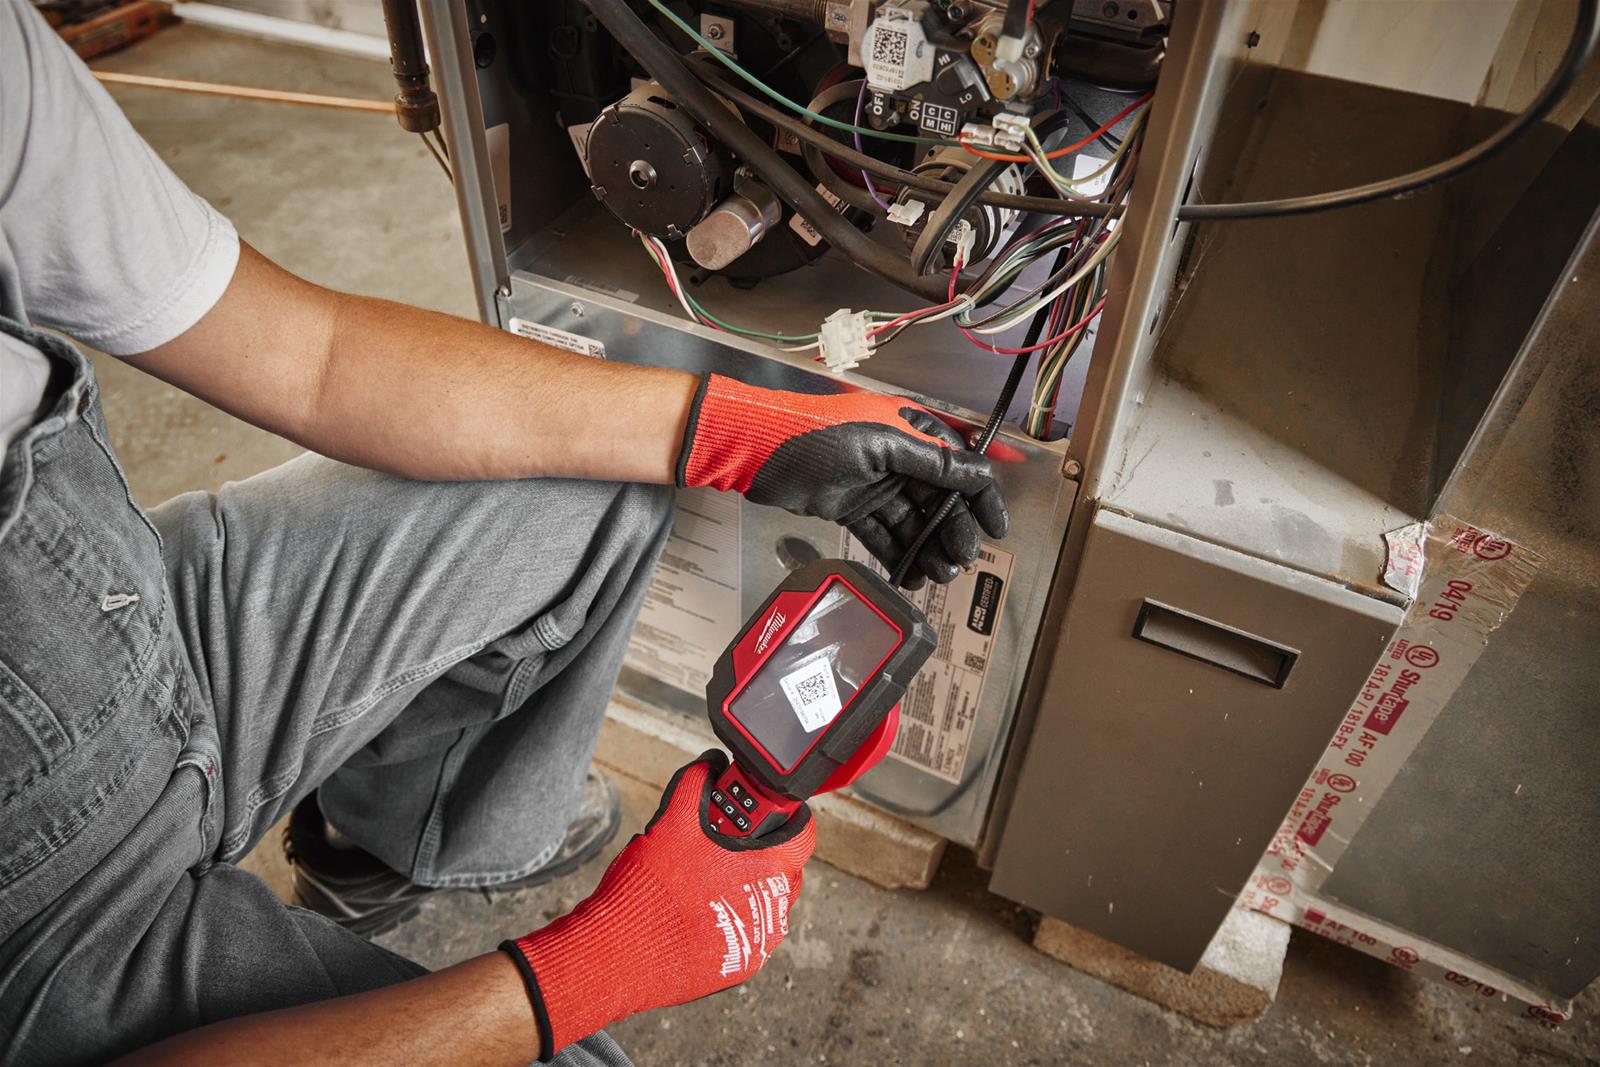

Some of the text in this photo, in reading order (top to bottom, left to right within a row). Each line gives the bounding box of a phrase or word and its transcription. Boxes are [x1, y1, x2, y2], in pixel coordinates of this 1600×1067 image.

[938, 53, 951, 66] HI
[910, 99, 921, 120] ON
[928, 107, 952, 119] C C
[926, 119, 952, 132] M HI
[1429, 580, 1473, 621] 04/19
[755, 612, 786, 654] Milwaukee
[1390, 639, 1409, 660] LISTED
[1360, 663, 1392, 702] 181A-P
[1373, 667, 1421, 722] Shurtape
[1330, 707, 1364, 750] 181B-FX
[1356, 731, 1377, 750] AF
[1344, 748, 1368, 768] 100
[748, 894, 760, 925] LEVEL
[713, 901, 742, 977] Milwaukee
[753, 927, 761, 944] CUT
[1326, 920, 1377, 946] AF 100
[1444, 970, 1498, 998] 02/19
